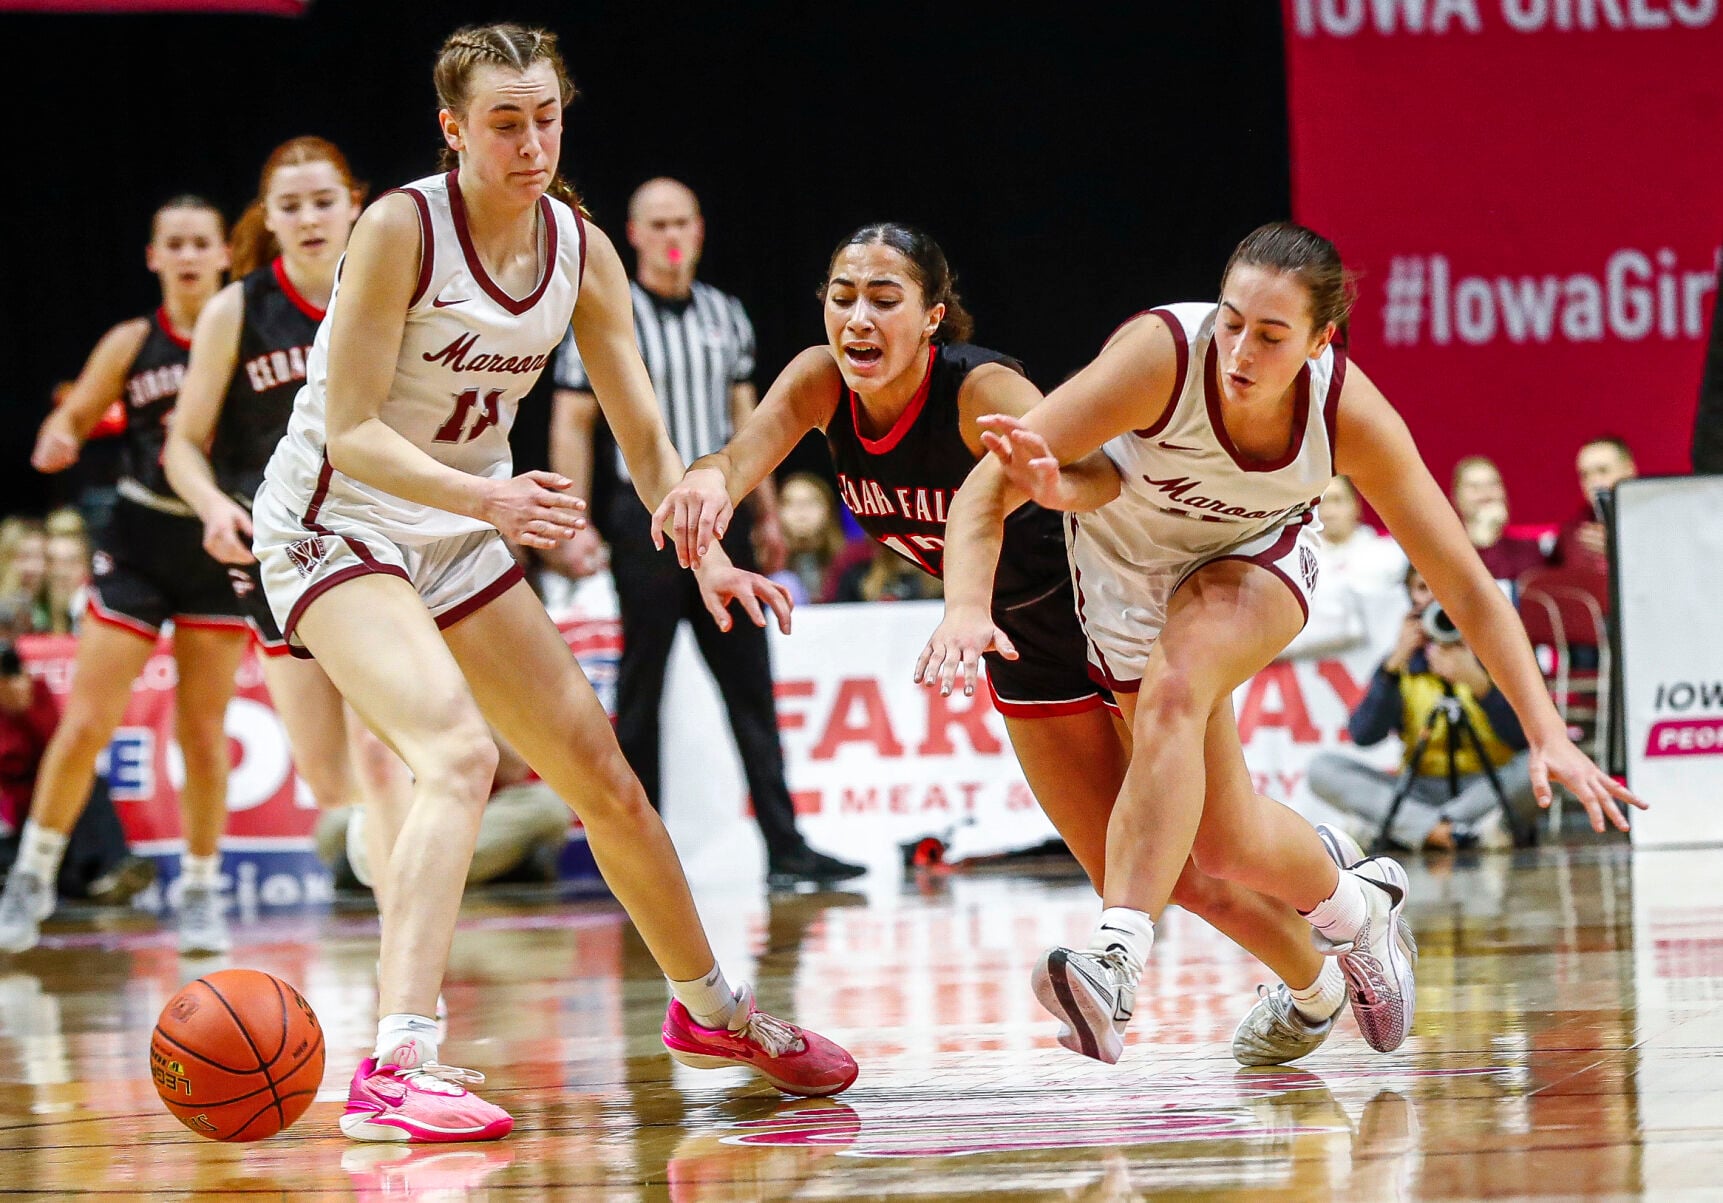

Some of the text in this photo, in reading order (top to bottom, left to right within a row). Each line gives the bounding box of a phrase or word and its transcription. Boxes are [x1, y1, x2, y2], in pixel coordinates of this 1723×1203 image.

[1383, 247, 1723, 345] #IowaGir
[245, 344, 313, 393] CEDA
[840, 782, 983, 816] MEAT
[151, 1064, 192, 1097] LEG
